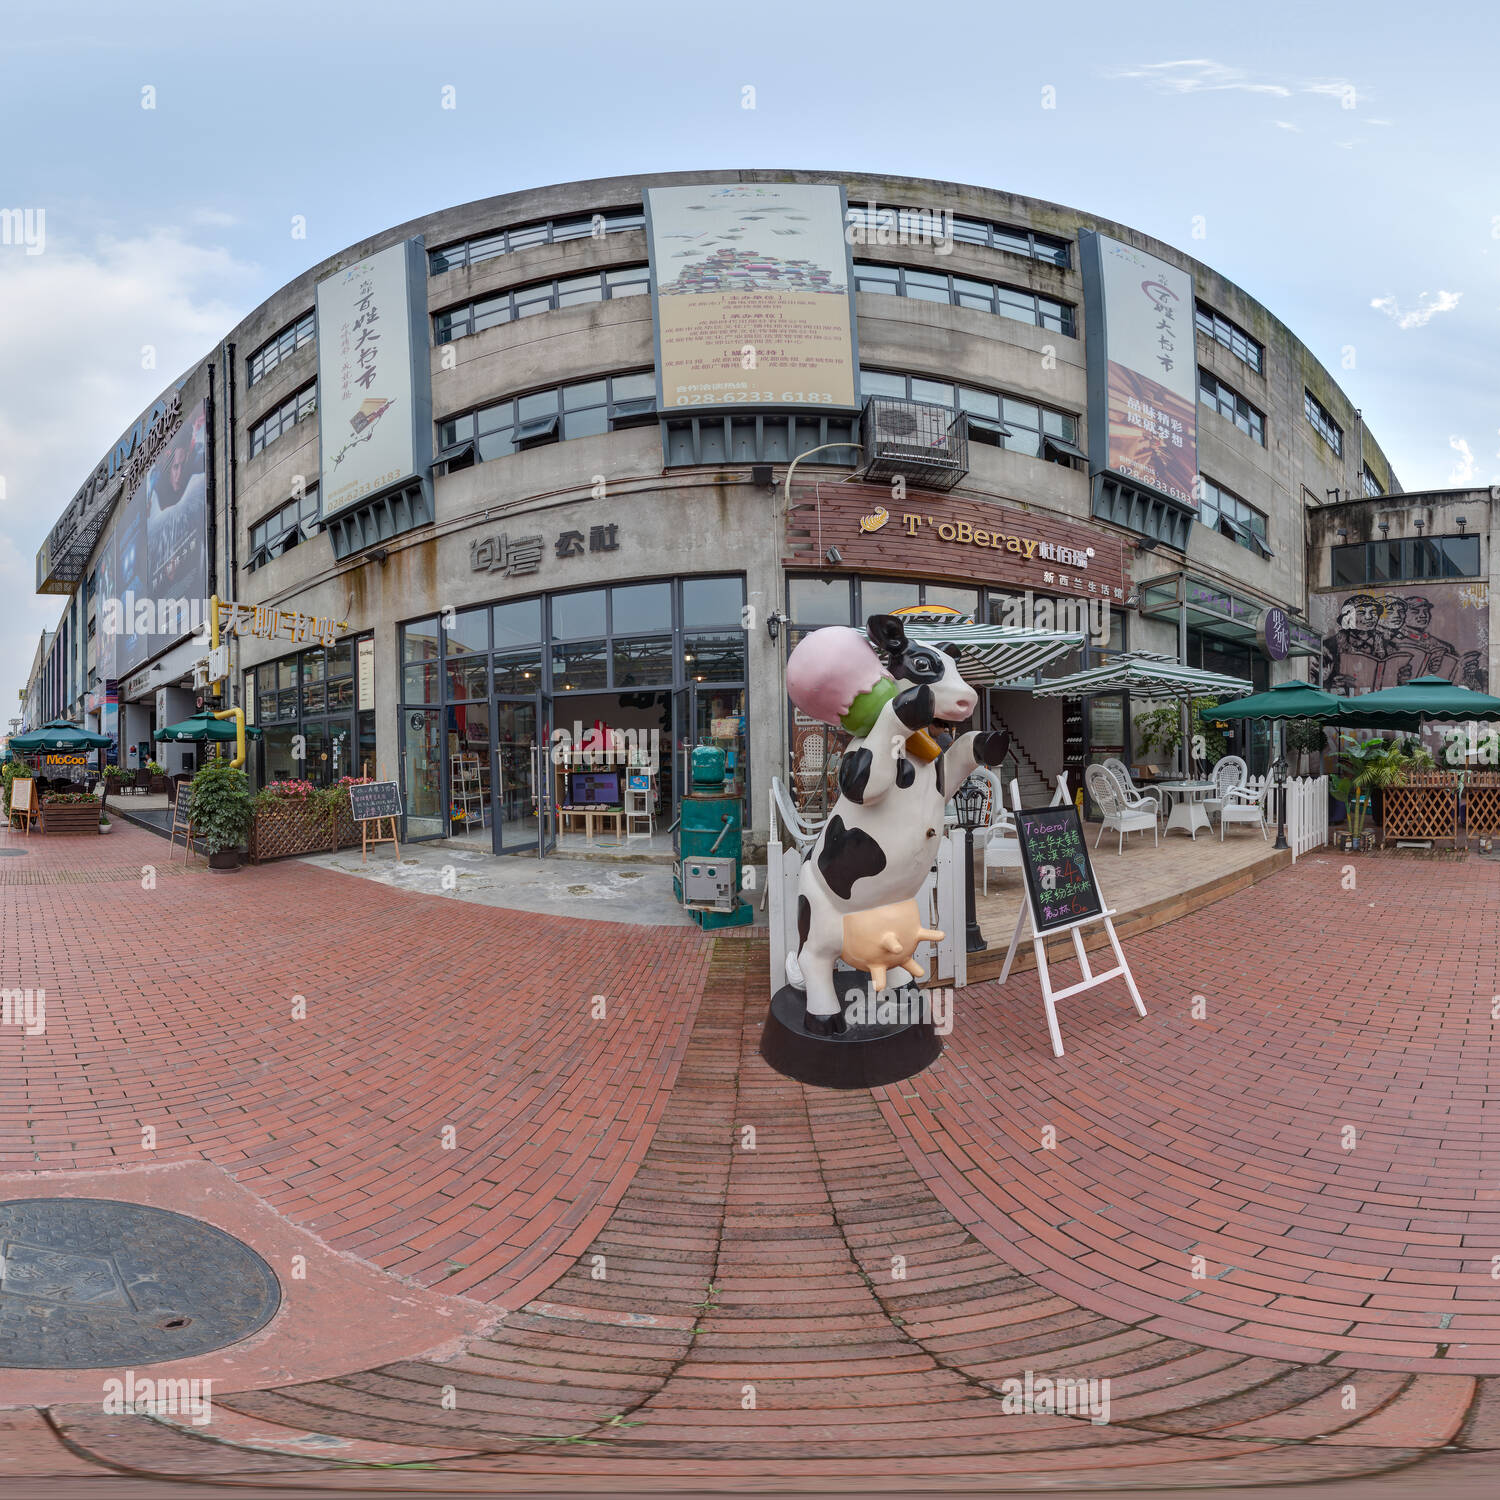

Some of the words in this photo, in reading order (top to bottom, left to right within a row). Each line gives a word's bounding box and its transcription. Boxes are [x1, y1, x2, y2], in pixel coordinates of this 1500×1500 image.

[676, 392, 774, 406] 028-6233
[781, 391, 833, 404] 6183
[1127, 395, 1183, 433] 品味精彩
[1127, 411, 1183, 448] 成就梦想
[327, 482, 371, 512] 028-6233
[373, 468, 401, 489] 6183
[1119, 464, 1168, 492] 028-6233
[1169, 487, 1192, 504] 6183
[1043, 570, 1124, 600] 新西兰生活馆
[46, 754, 86, 765] MoCoo
[1032, 847, 1077, 862] 冰淇淋
[1040, 880, 1092, 905] 缤纷圣代杯
